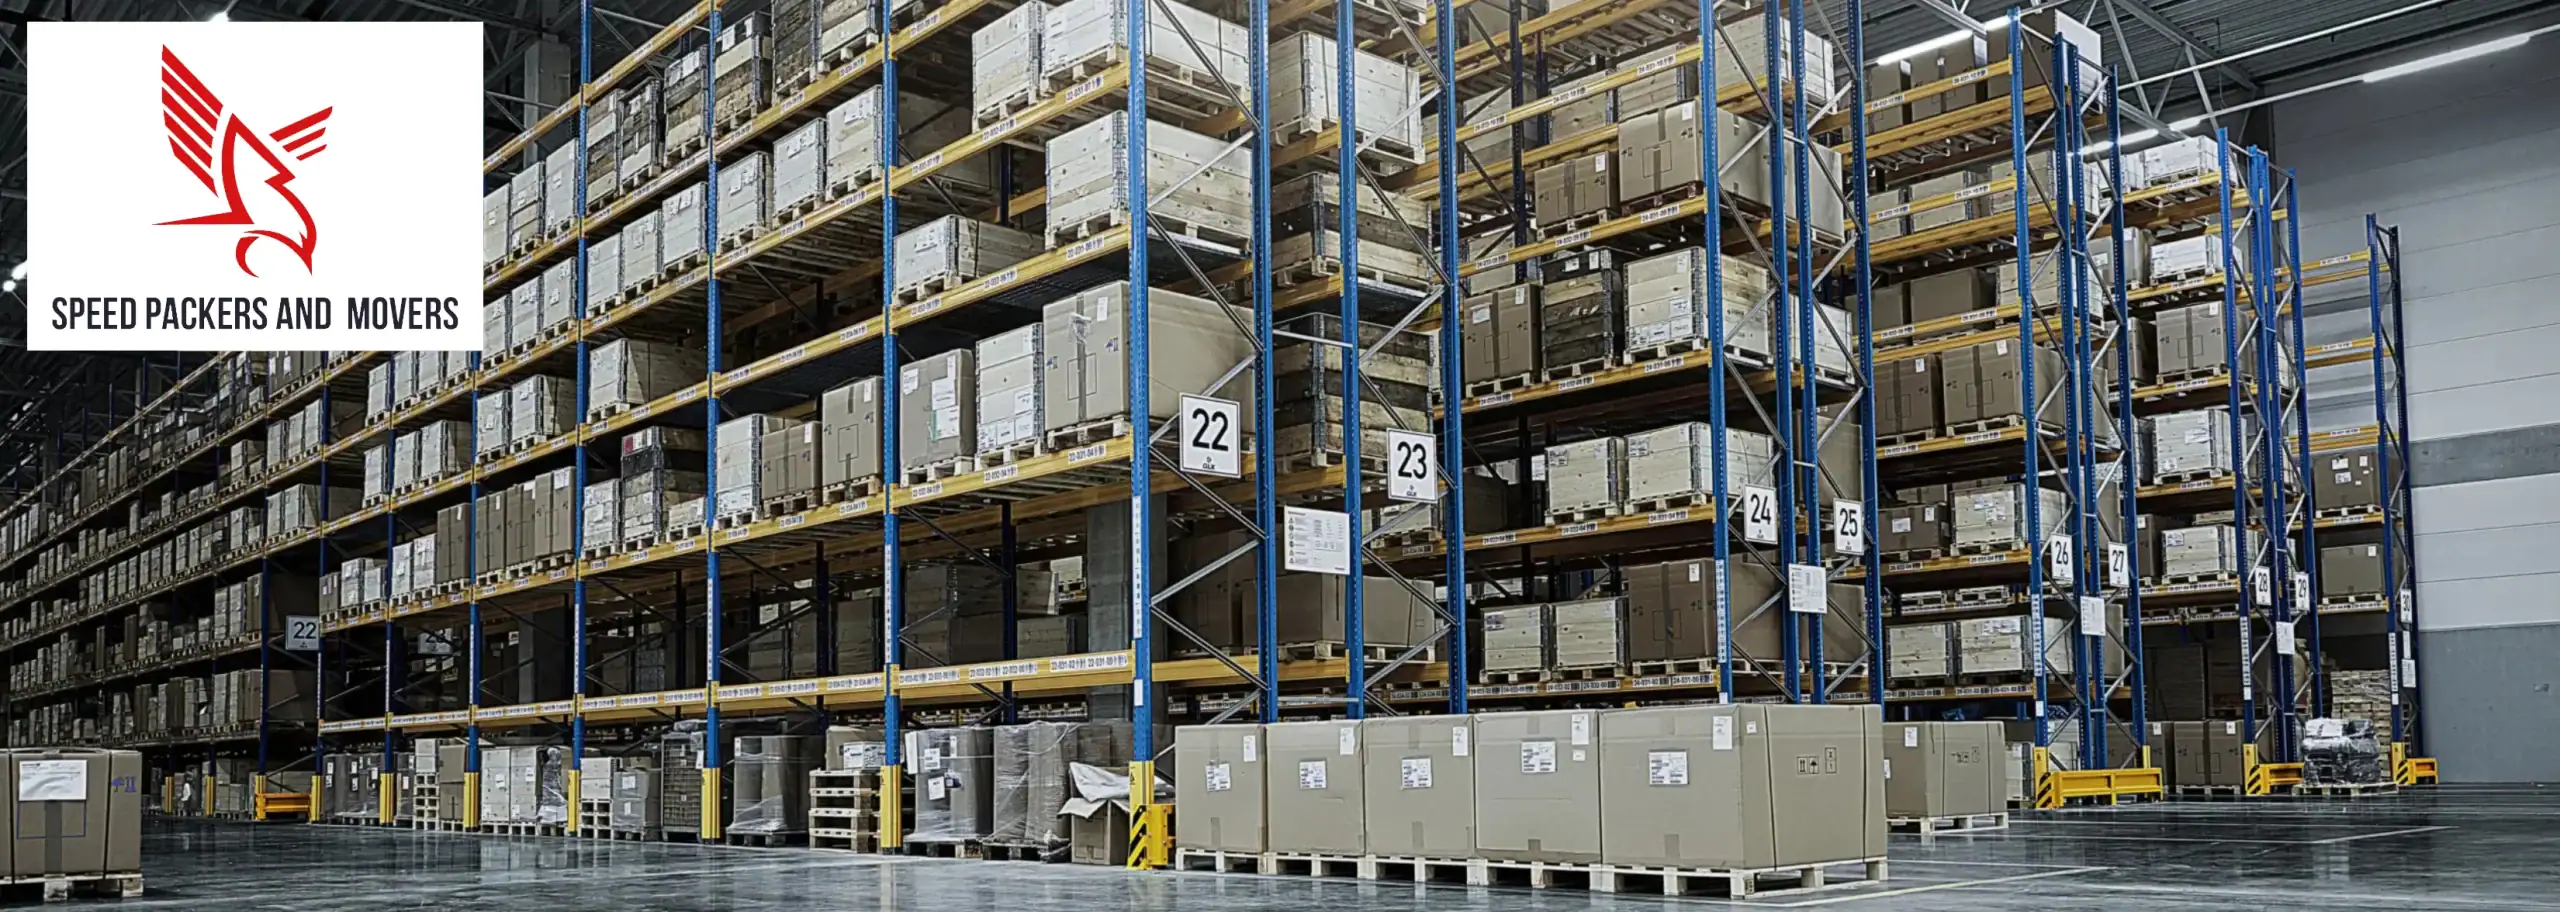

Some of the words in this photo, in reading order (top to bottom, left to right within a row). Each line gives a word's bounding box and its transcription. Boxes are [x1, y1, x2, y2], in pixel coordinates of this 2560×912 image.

[1192, 408, 1229, 452] 22
[1397, 441, 1427, 480] 23
[1750, 494, 1771, 525] 24
[1840, 508, 1858, 537] 25
[2055, 541, 2069, 566] 26
[2111, 550, 2125, 573] 27
[2258, 572, 2268, 592] 28
[2298, 578, 2307, 598] 29
[2402, 594, 2411, 612] 30
[293, 622, 317, 639] 22
